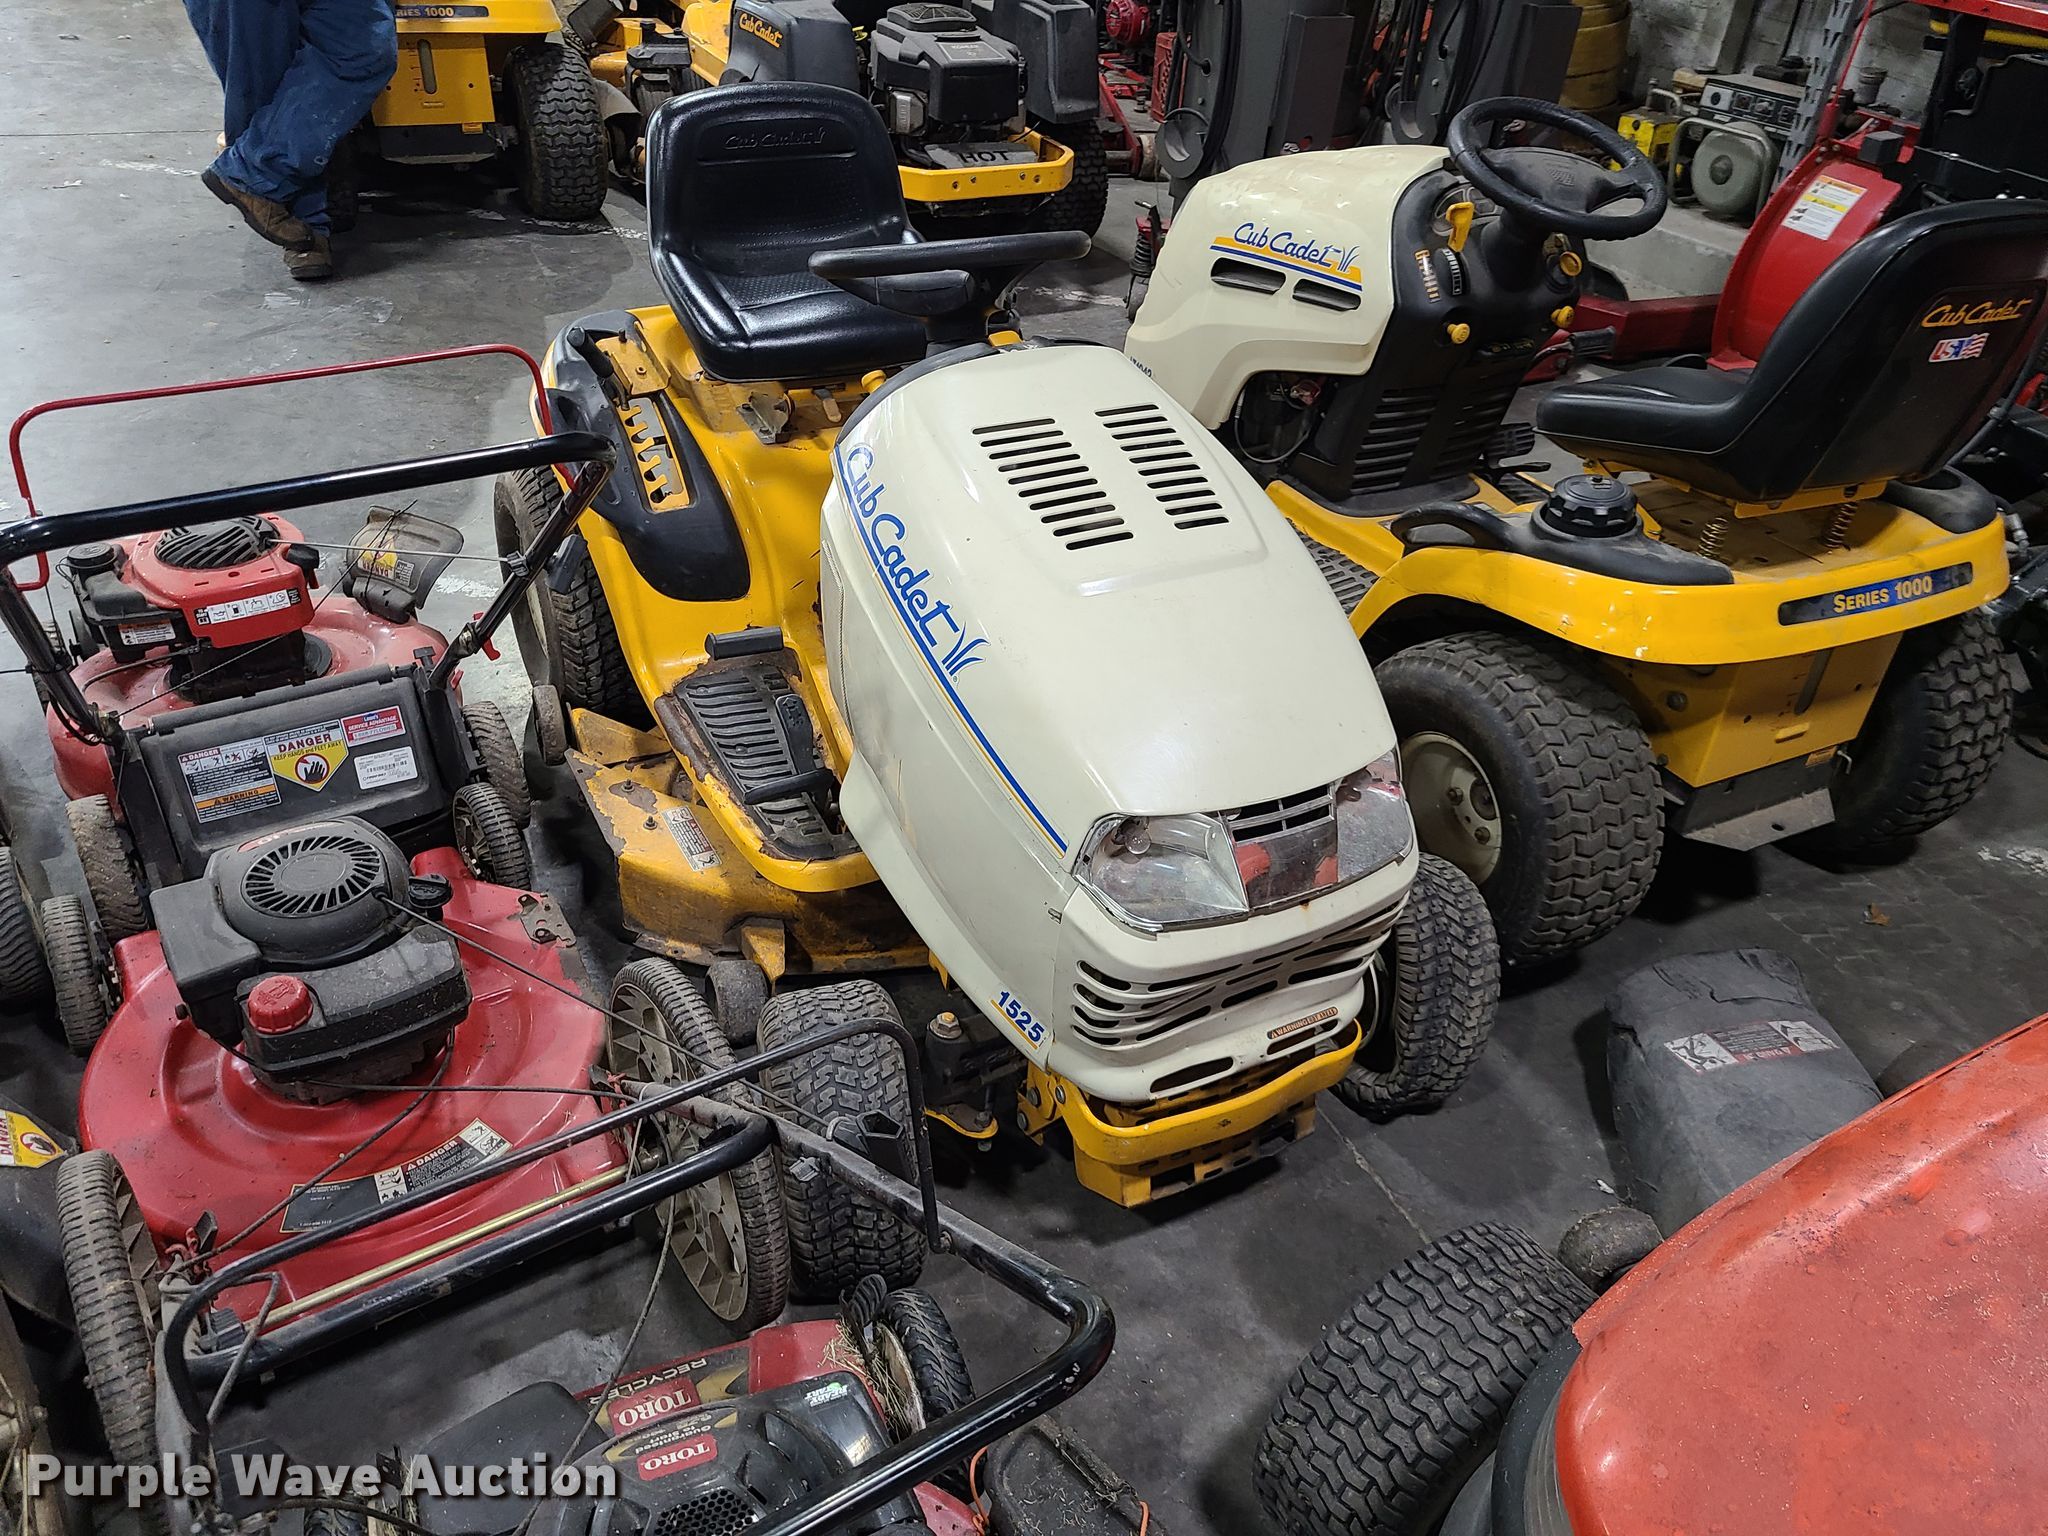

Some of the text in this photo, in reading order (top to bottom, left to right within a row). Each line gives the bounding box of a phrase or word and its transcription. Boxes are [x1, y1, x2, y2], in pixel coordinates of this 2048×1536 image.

[396, 7, 454, 17] RIES 1000
[739, 13, 783, 48] Cub Cadet
[958, 150, 1009, 164] HOT
[1234, 222, 1342, 267] Cub Cadet
[1921, 299, 2033, 328] Cub Cadet
[846, 446, 960, 648] Cub Cadet
[1833, 575, 1933, 614] SERIES 1000
[188, 748, 219, 760] DANGER
[273, 753, 287, 761] KEEP
[287, 748, 305, 758] HANDS
[314, 743, 327, 752] FEET
[327, 740, 342, 750] AWAY
[278, 733, 332, 753] DANGER
[222, 789, 259, 803] WARNING
[998, 991, 1045, 1042] 1525
[1276, 1019, 1308, 1037] WARNING
[416, 1139, 459, 1167] DANGER
[618, 1388, 692, 1428] TORO
[635, 1424, 712, 1455] Guaranteed
[650, 1430, 681, 1444] Start
[644, 1442, 711, 1471] TORO
